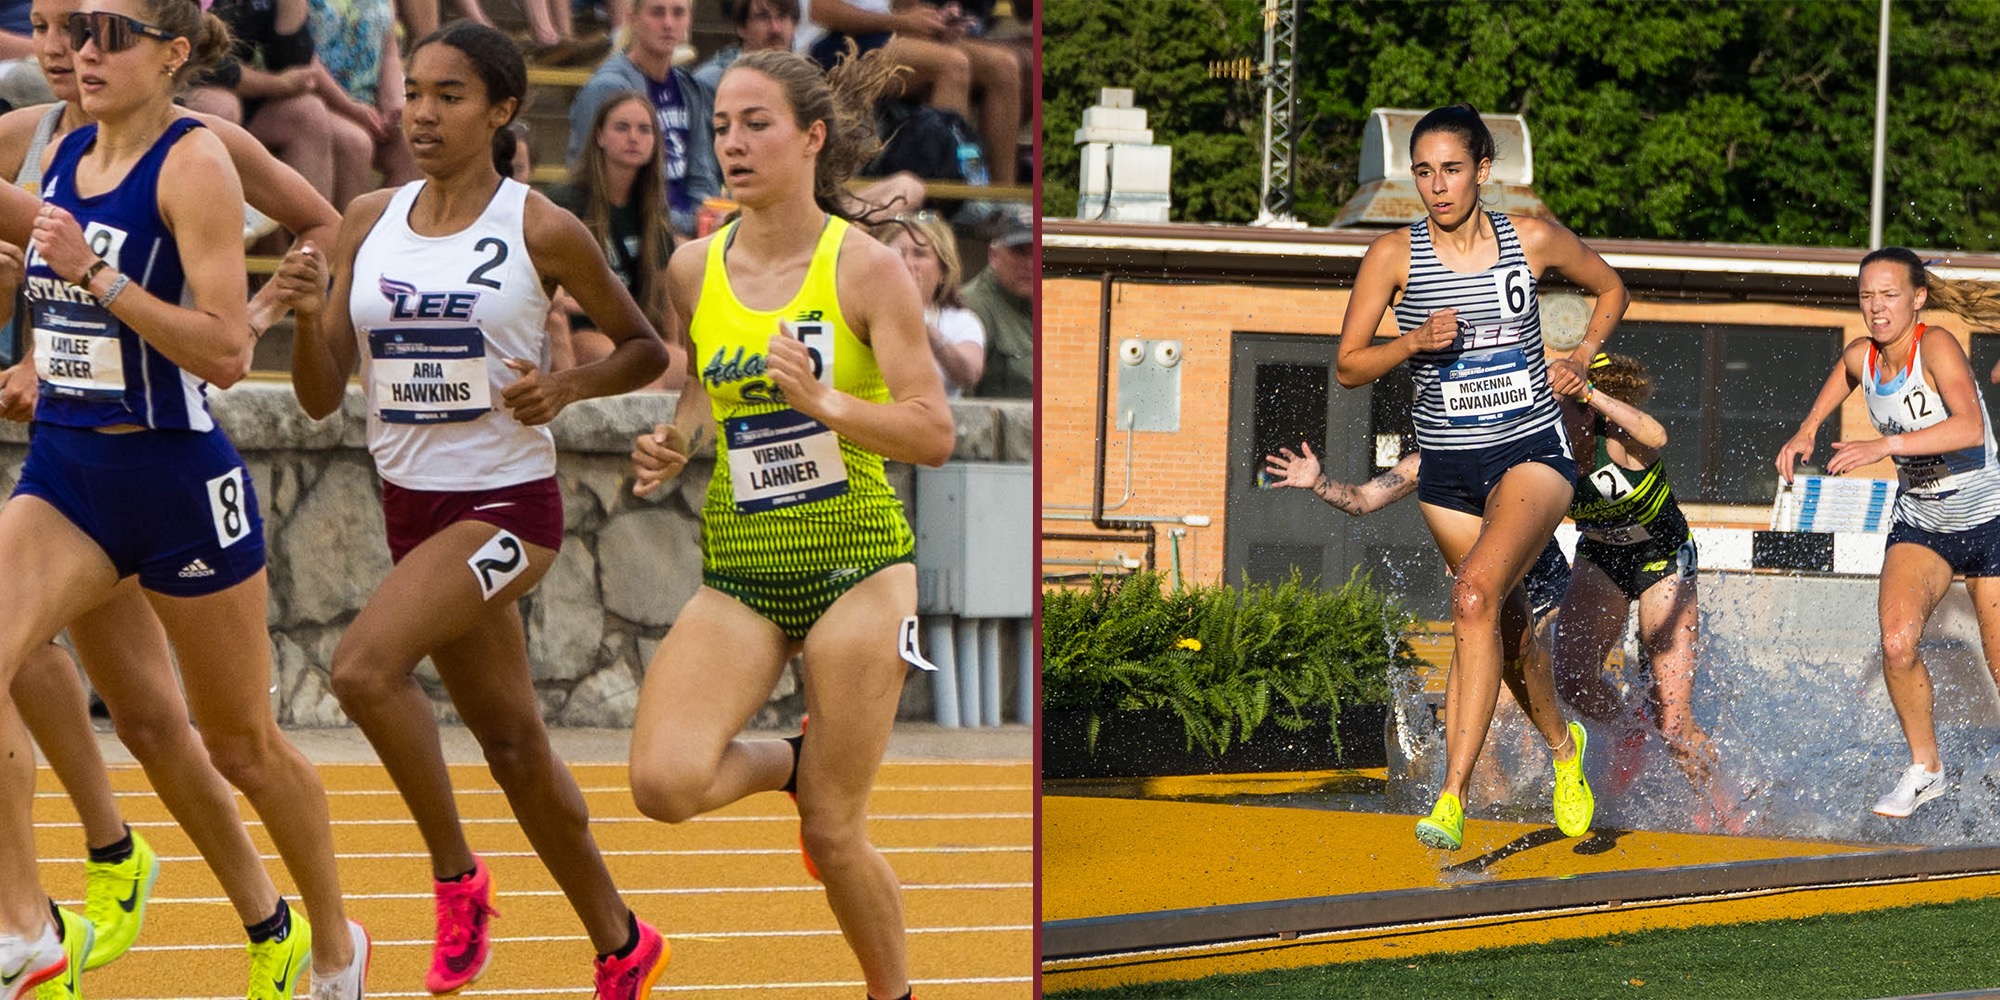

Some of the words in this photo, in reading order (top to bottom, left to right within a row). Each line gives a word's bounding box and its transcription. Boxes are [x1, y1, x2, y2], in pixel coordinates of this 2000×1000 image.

[467, 237, 508, 290] 2
[390, 291, 480, 321] LEE
[1504, 270, 1526, 314] 6
[798, 326, 823, 380] 5
[413, 362, 444, 379] ARIA
[1459, 376, 1513, 394] MCKENNA
[392, 382, 471, 402] HAWKINS
[1449, 387, 1528, 411] CAVANAUGH
[1903, 390, 1933, 420] 12
[752, 443, 805, 465] VIENNA
[750, 460, 820, 490] LAHNER
[1597, 470, 1628, 500] 2
[219, 477, 242, 538] 8
[178, 568, 216, 578] adidas
[475, 536, 521, 592] 2
